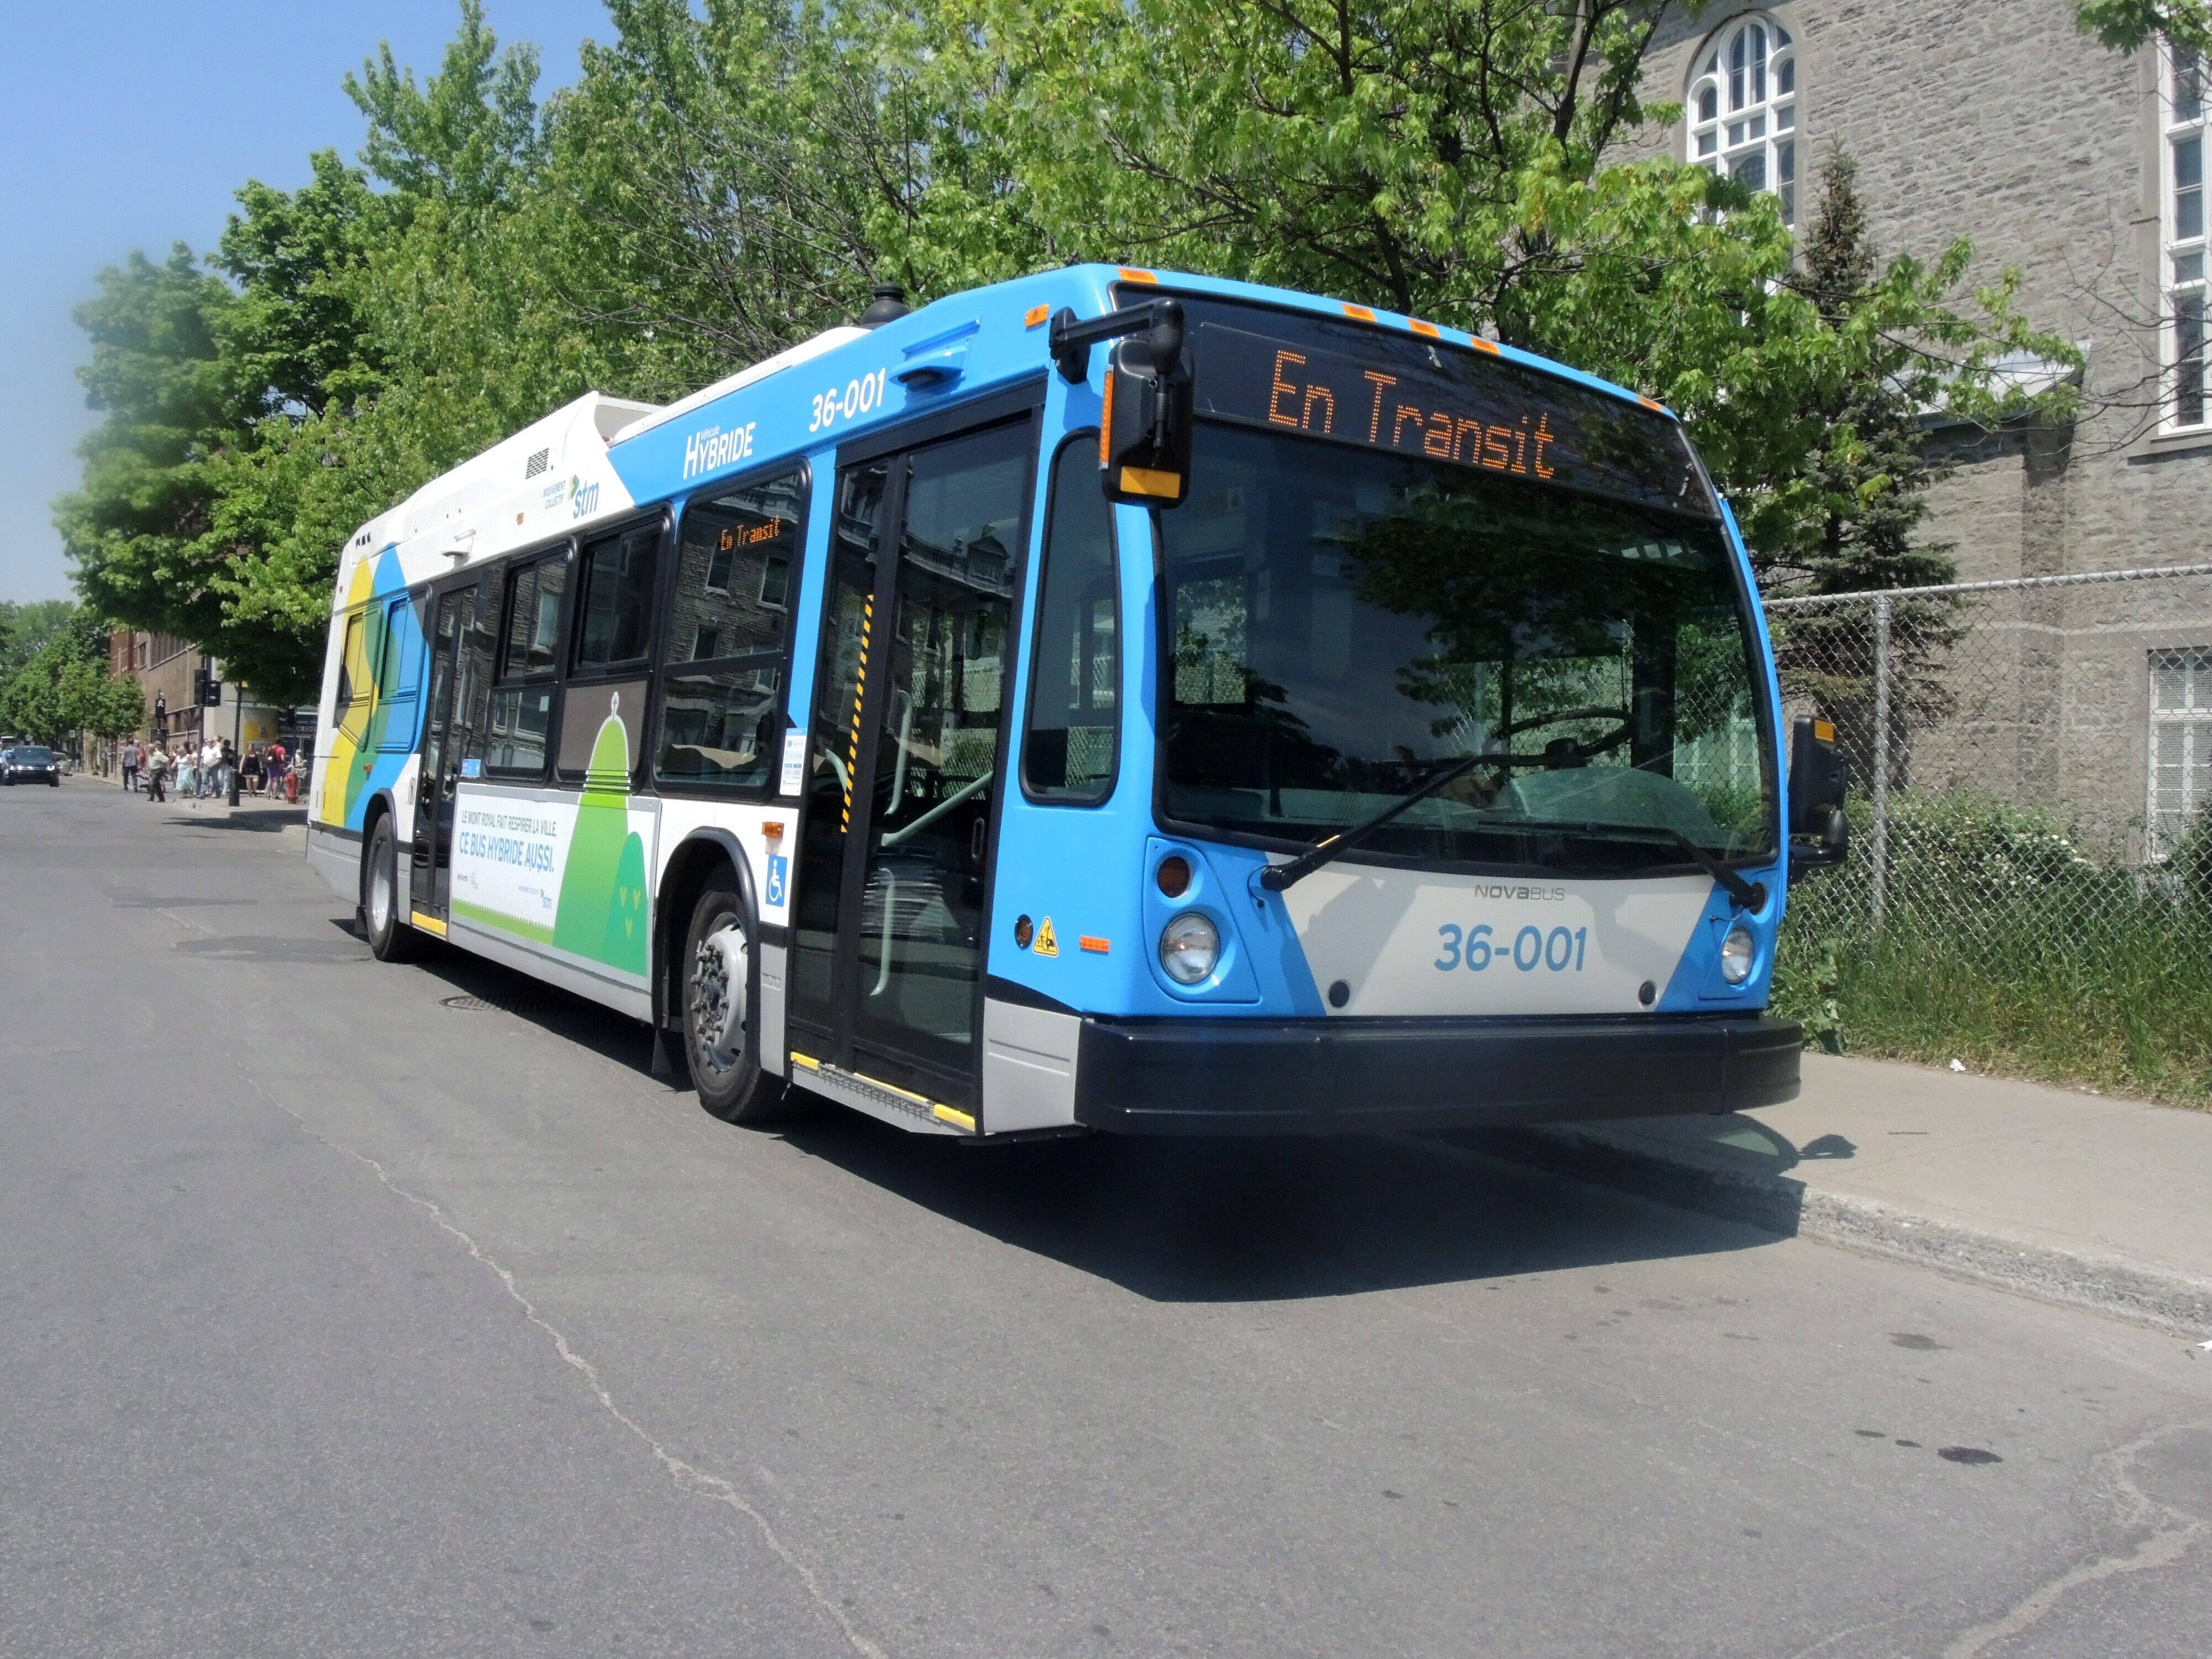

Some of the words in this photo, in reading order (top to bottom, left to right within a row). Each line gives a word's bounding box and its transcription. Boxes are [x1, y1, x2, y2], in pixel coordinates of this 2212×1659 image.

[808, 367, 885, 432] 36-001
[1269, 349, 1334, 434] En
[1364, 370, 1554, 478] Transit
[683, 421, 756, 480] HYBRIDE
[573, 480, 599, 519] stm
[721, 529, 733, 551] En
[737, 514, 780, 547] Transit
[462, 810, 467, 823] LE
[468, 811, 481, 825] MONT
[481, 812, 496, 828] ROYAL
[497, 814, 508, 829] FAIT
[508, 816, 532, 833] RESPIRER
[533, 818, 539, 834] LA
[460, 831, 469, 854] CE
[470, 833, 487, 858] BUS
[487, 836, 524, 866] HYBRIDE
[524, 842, 555, 873] AUSSI.
[1434, 923, 1587, 972] 36-001
